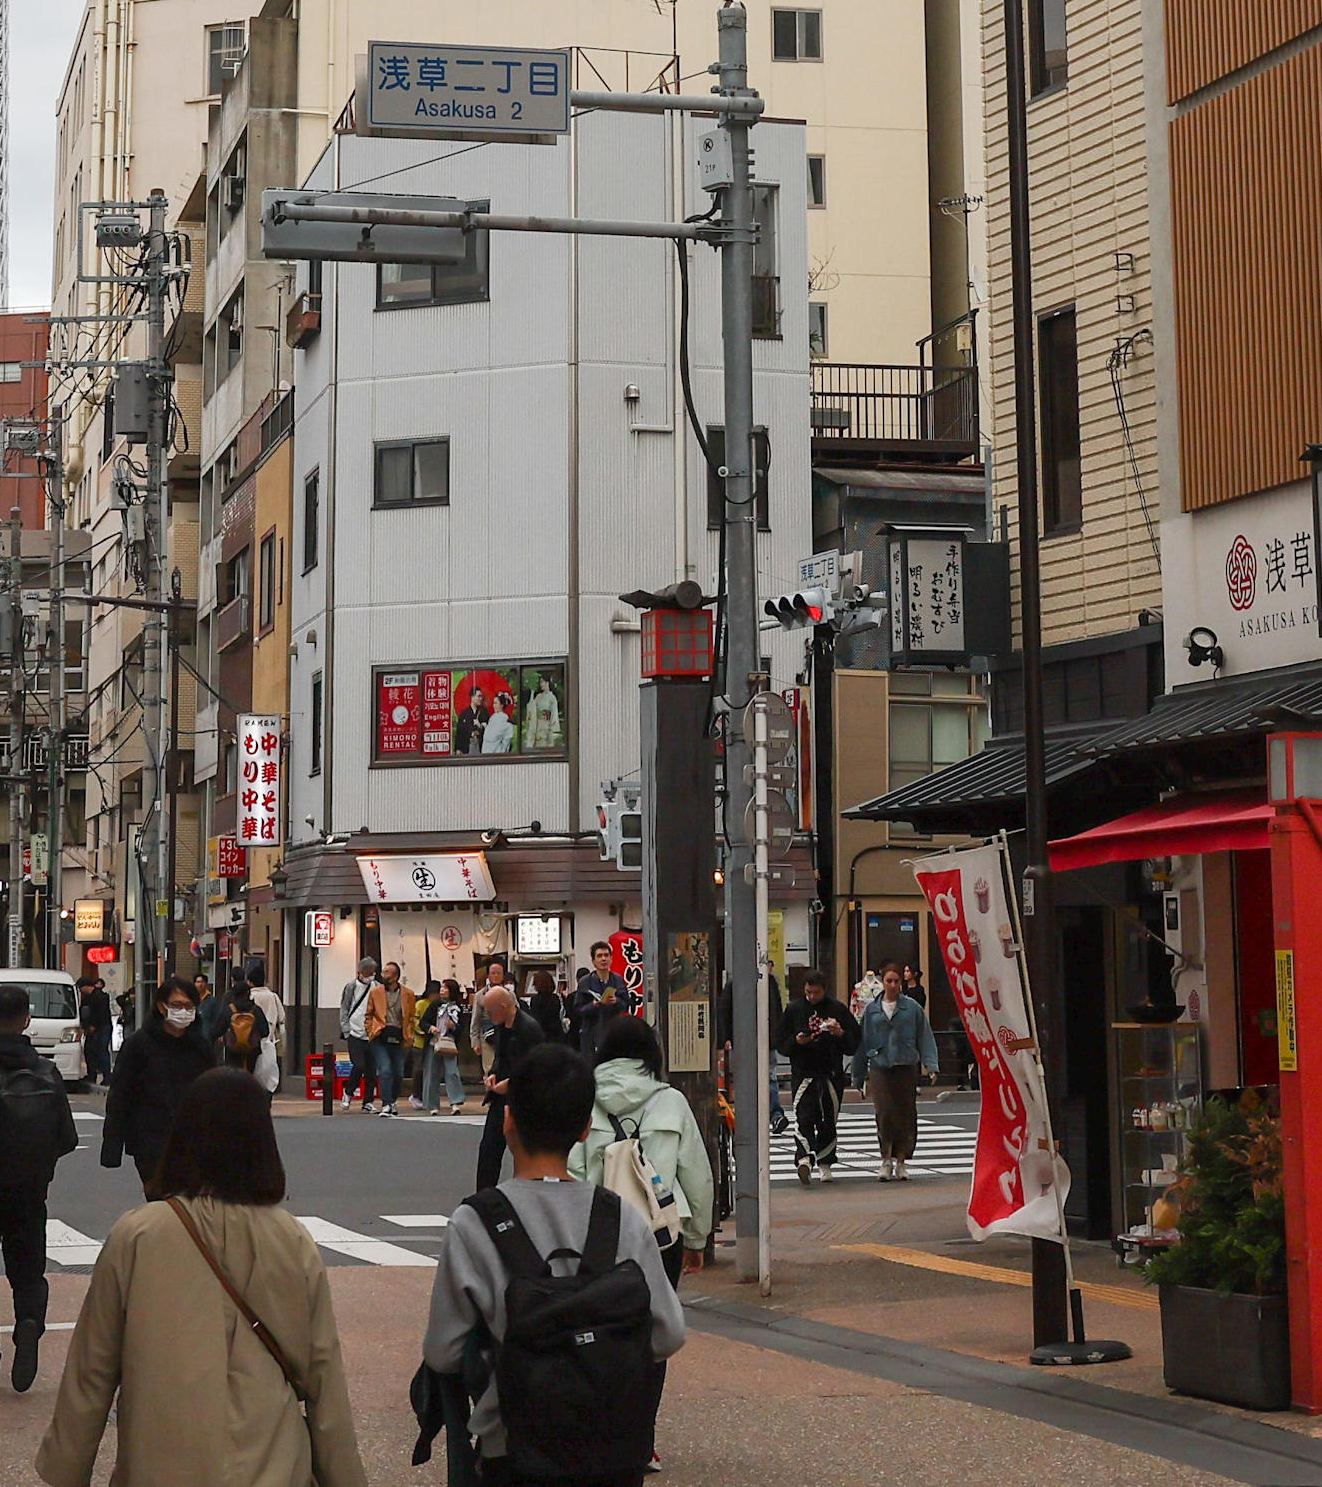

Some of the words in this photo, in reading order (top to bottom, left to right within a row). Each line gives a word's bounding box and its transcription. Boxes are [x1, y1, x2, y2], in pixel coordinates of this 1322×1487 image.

[378, 55, 558, 96] 浅草二丁目
[414, 97, 497, 120] Asakusa
[511, 101, 523, 120] 2
[1264, 531, 1313, 595] 浅草
[930, 571, 945, 634] おむすび
[945, 544, 961, 625] 手作り弁当
[909, 564, 925, 649] 明るい農村
[1239, 609, 1296, 639] ASAKUSA
[244, 719, 277, 727] RAMEN
[242, 733, 259, 841] もり中華
[260, 732, 278, 841] 中華そば
[221, 851, 239, 862] コイン
[221, 863, 245, 874] ロッカー
[369, 860, 387, 899] もり中華
[458, 857, 478, 898] 中華そば
